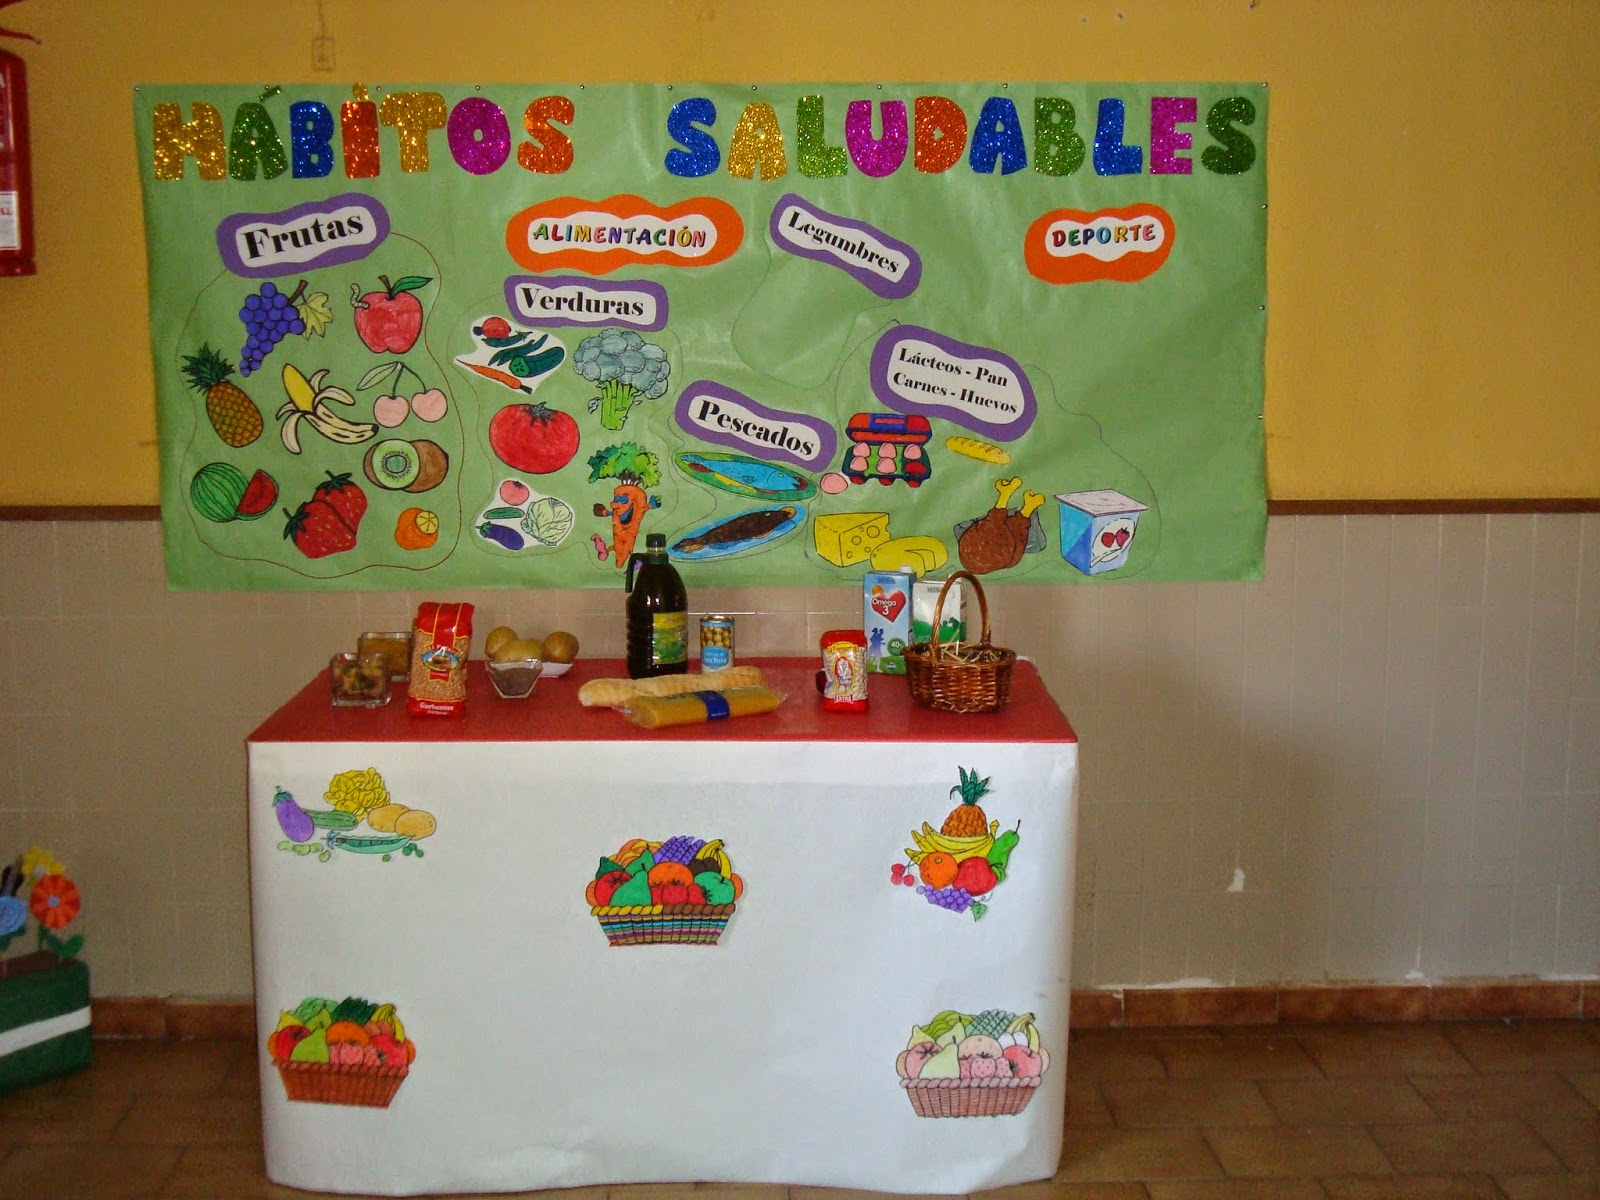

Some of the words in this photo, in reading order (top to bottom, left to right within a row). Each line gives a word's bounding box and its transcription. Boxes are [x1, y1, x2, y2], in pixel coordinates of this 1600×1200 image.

[664, 95, 1256, 181] SALUDABLES
[242, 205, 364, 260] Frutas
[533, 223, 706, 248] ALIMENTACIÓN
[786, 210, 901, 274] Legumbres
[1051, 223, 1156, 247] DEPORTE
[521, 287, 644, 316] Verduras
[898, 347, 962, 376] Lácteos
[975, 366, 1008, 387] Pan
[893, 372, 947, 397] Carnes
[960, 388, 1017, 414] Huevos
[697, 399, 814, 456] Pescados
[872, 598, 896, 607] Omega
[882, 606, 889, 615] 3
